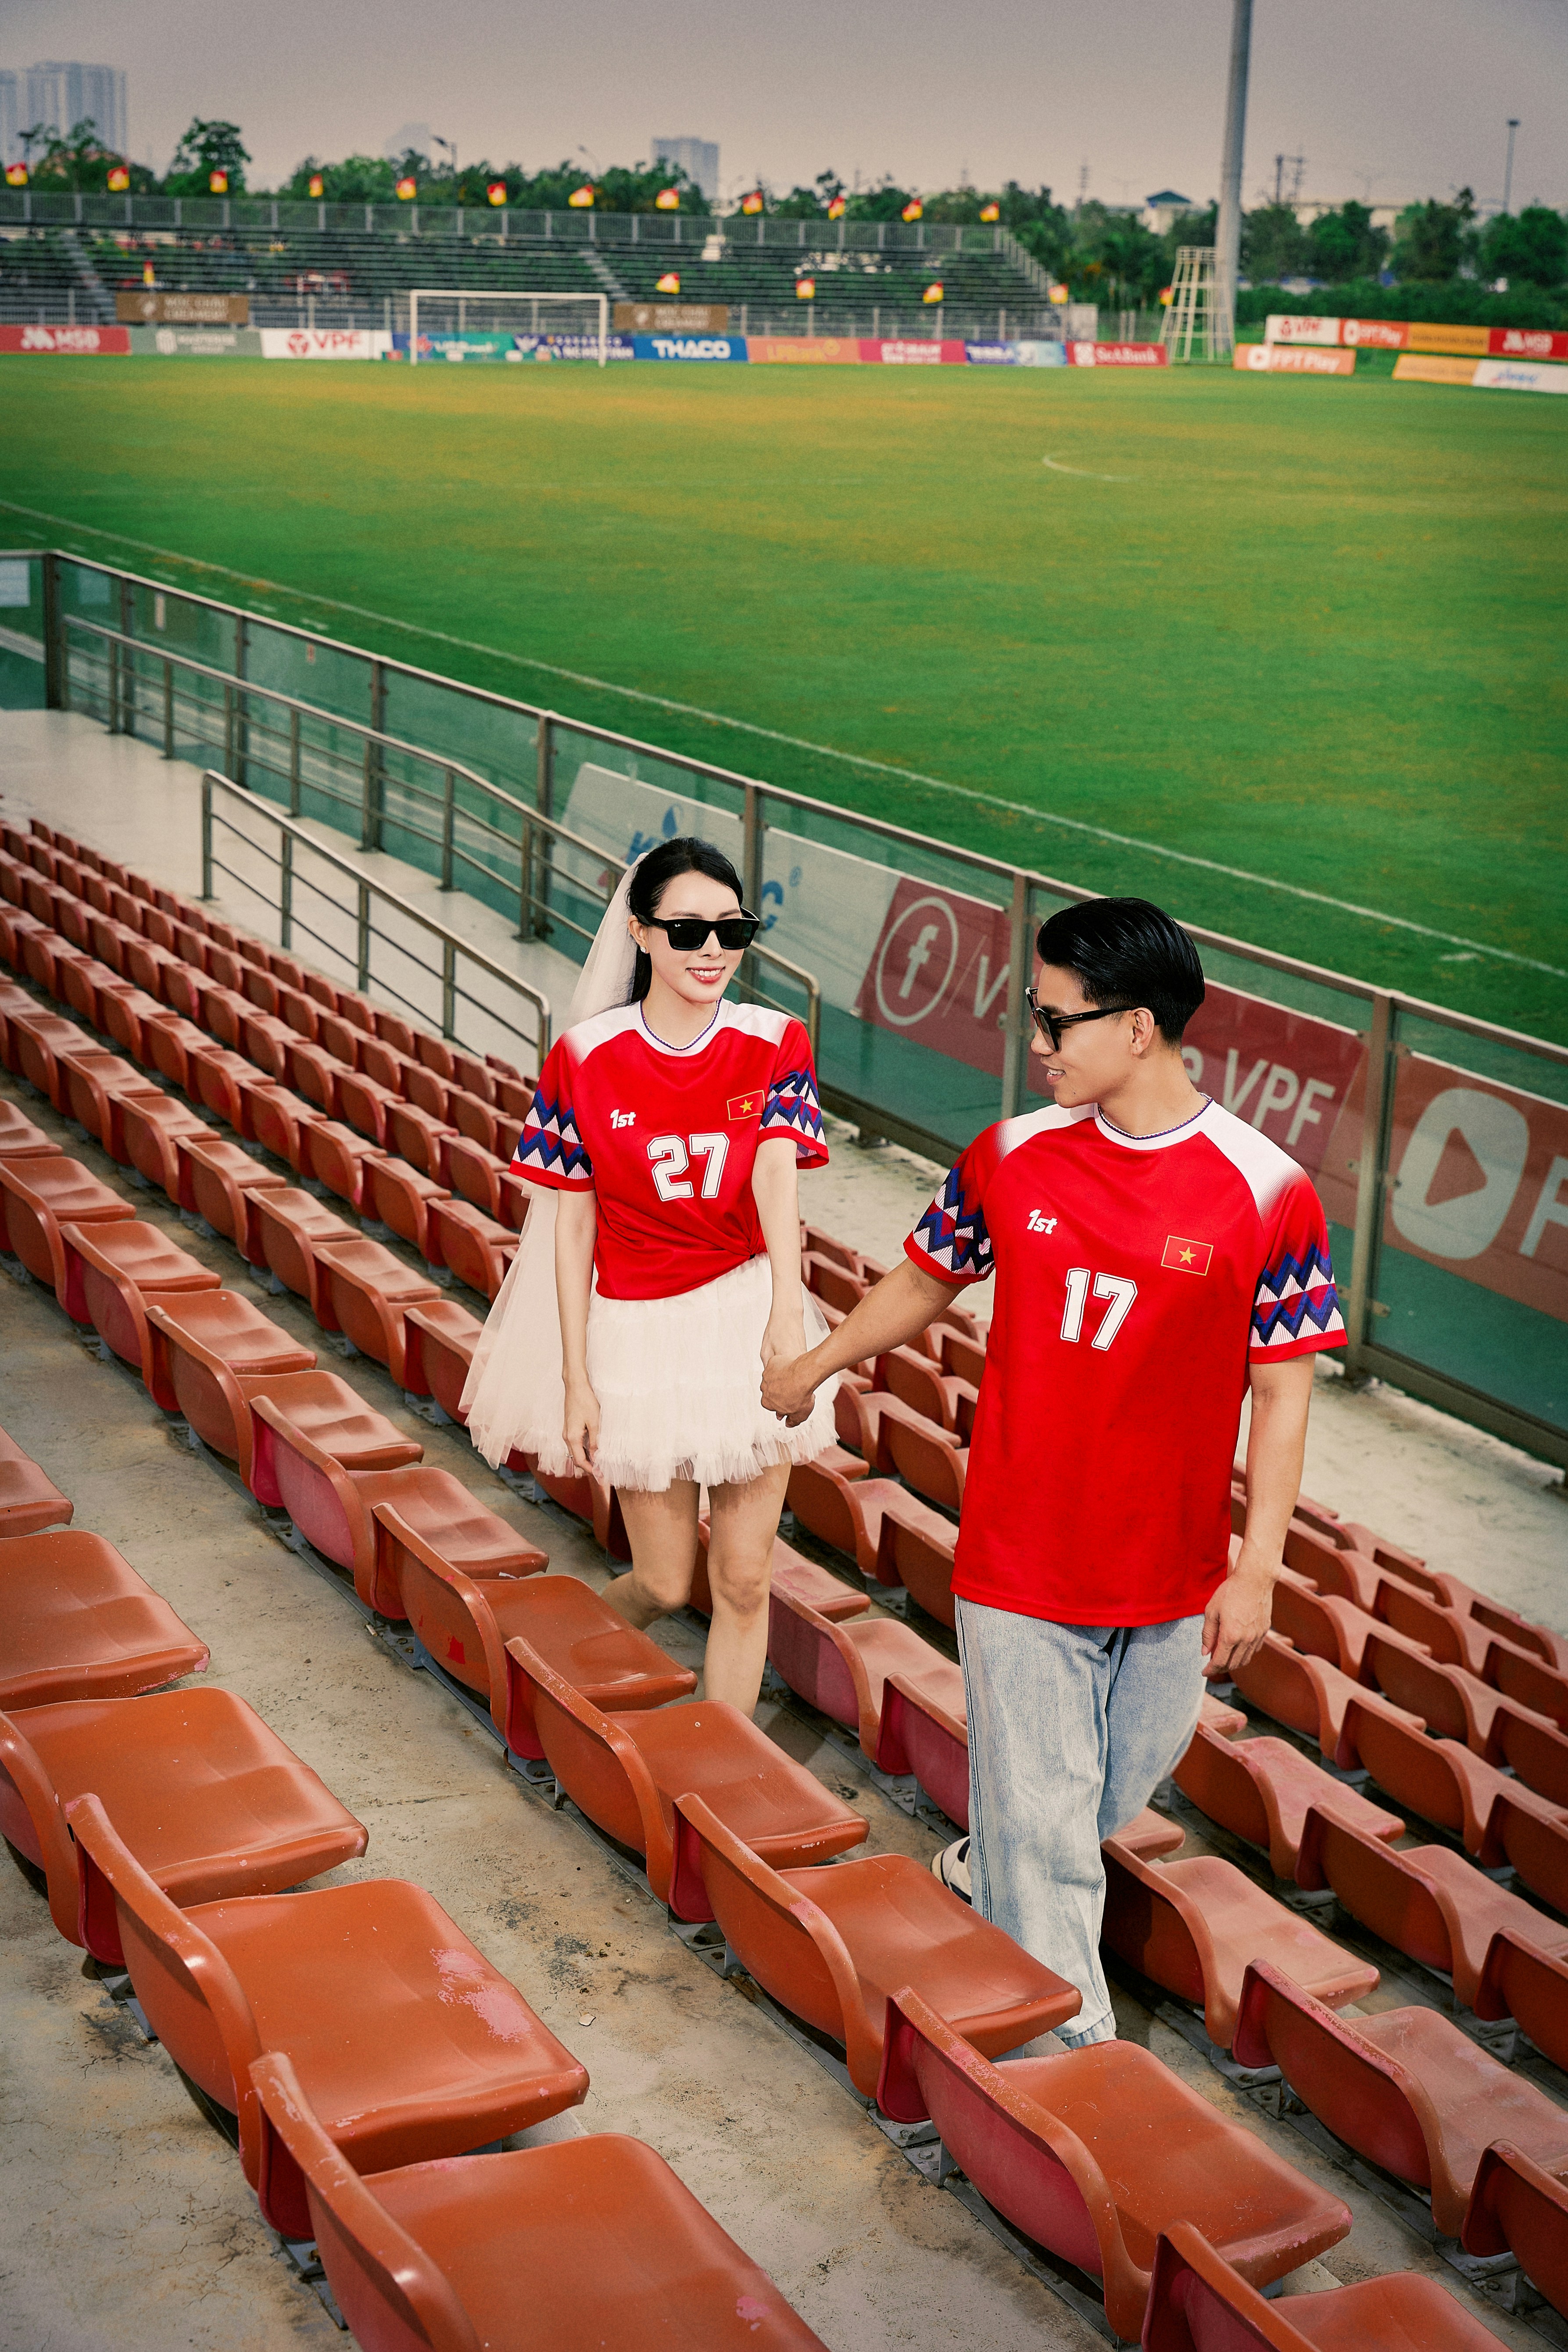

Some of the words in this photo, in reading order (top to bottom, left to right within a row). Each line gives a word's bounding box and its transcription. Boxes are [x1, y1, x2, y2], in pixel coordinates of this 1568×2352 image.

[312, 332, 362, 349] VPF
[652, 340, 730, 359] THACO
[1222, 1049, 1335, 1146] VPF
[610, 1109, 636, 1129] 1st
[647, 1132, 730, 1201] 27
[1027, 1209, 1058, 1235] 1st
[1060, 1267, 1138, 1351] 17
